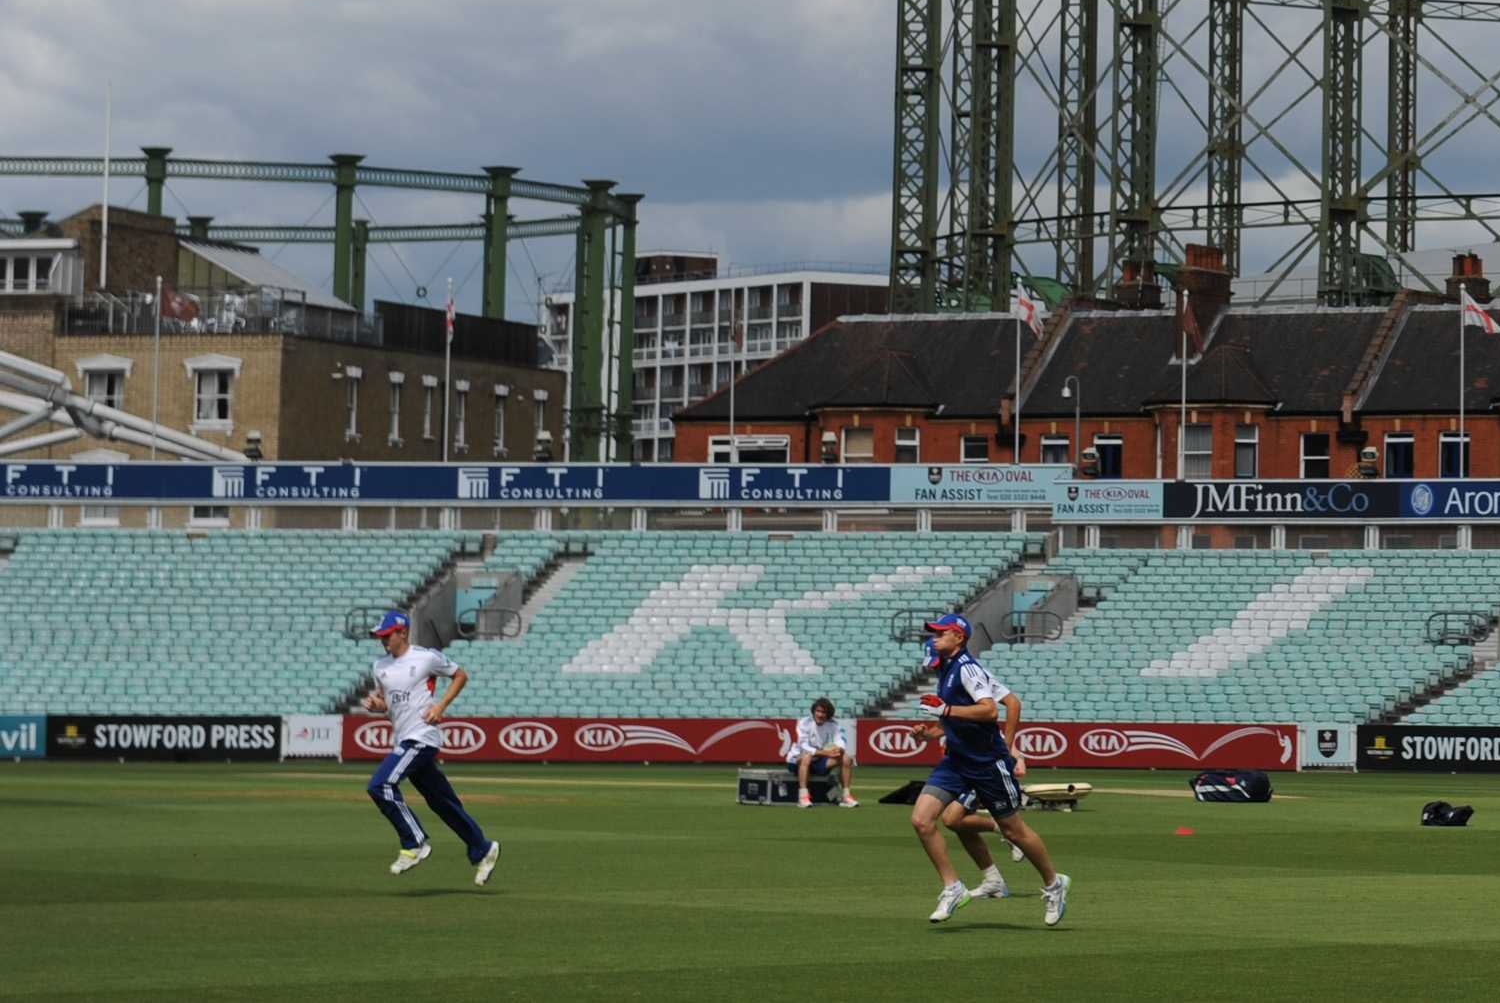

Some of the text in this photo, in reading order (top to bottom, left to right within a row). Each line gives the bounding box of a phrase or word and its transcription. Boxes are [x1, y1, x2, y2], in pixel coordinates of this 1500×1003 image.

[950, 469, 1033, 483] THE KIA OVAL
[6, 485, 113, 496] CONSULTING
[256, 486, 360, 498] CONSULTING
[500, 487, 603, 499] CONSULTING
[741, 488, 843, 499] CONSULTING
[915, 488, 939, 501] FAN
[941, 488, 983, 501] ASSIST
[1085, 489, 1149, 499] THE KIA OVAL
[1057, 503, 1075, 514] FAN
[1077, 503, 1110, 514] ASSIST
[94, 724, 276, 749] STOWFORD PRESS
[508, 728, 548, 746] KIA
[583, 730, 616, 746] KIA
[1019, 734, 1058, 752] KIA
[1087, 734, 1119, 751] KIA
